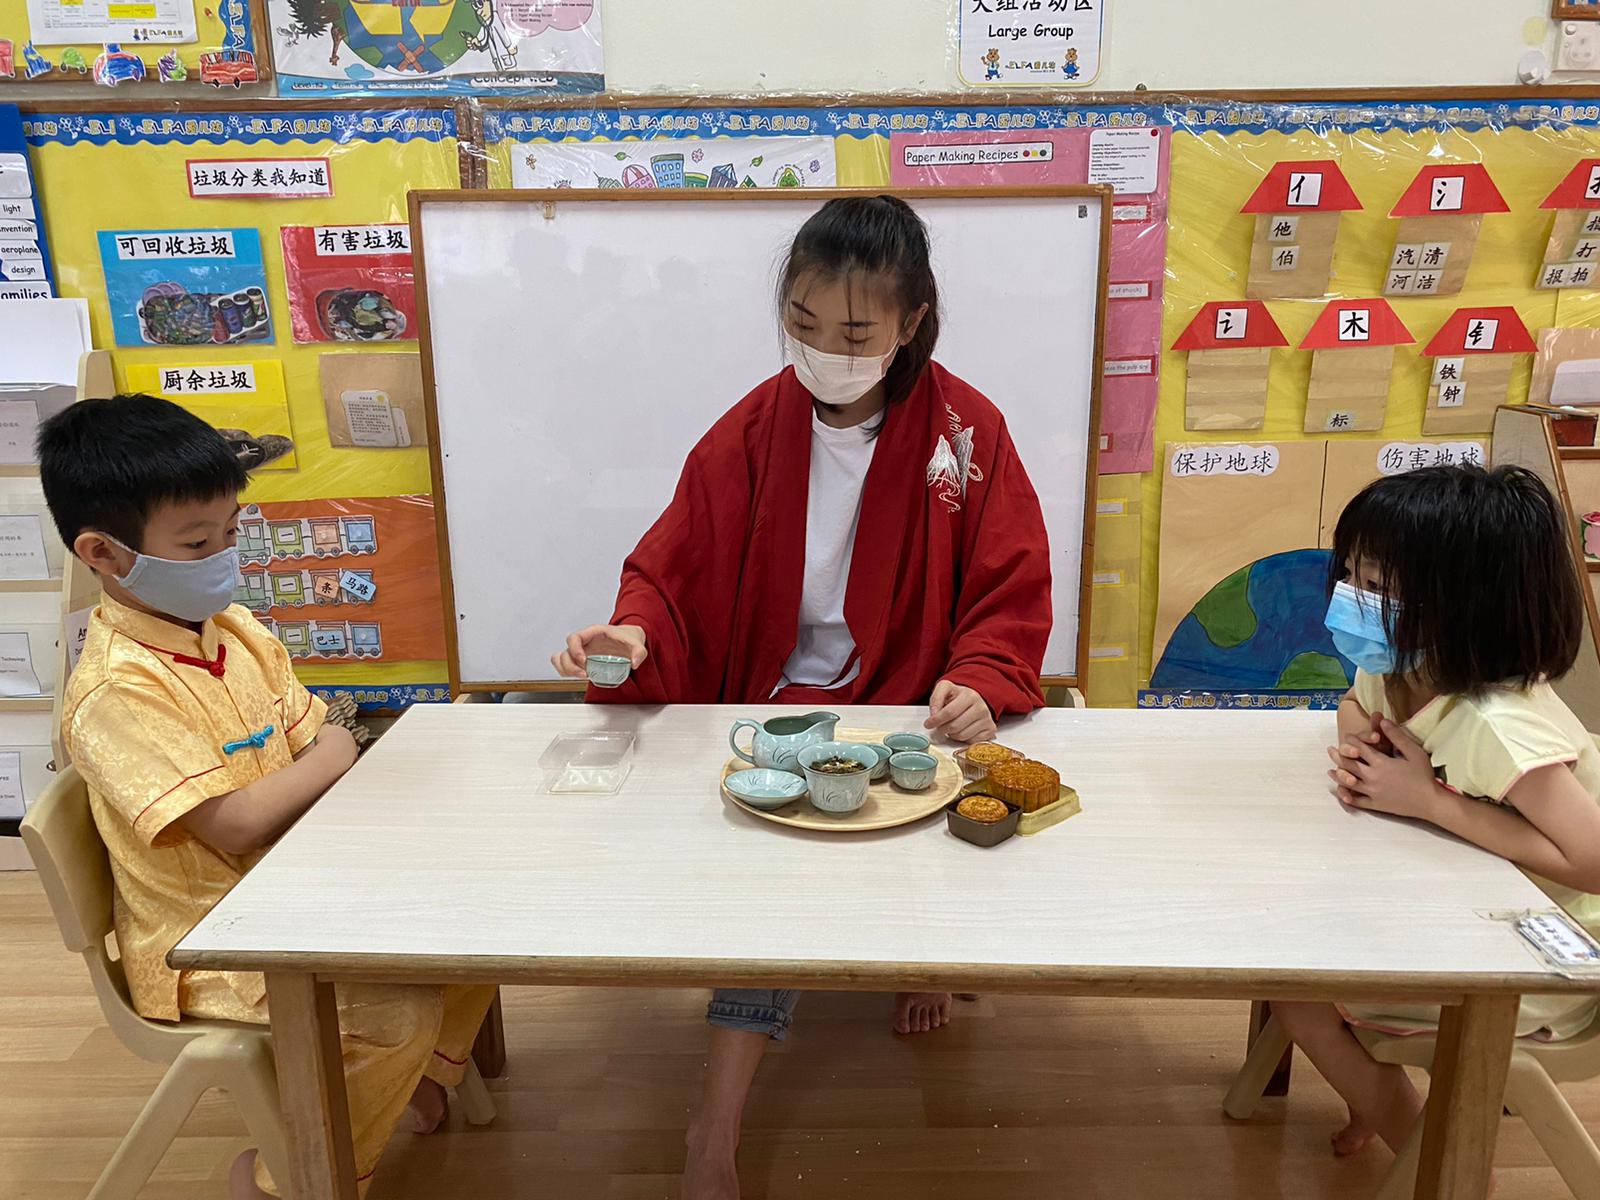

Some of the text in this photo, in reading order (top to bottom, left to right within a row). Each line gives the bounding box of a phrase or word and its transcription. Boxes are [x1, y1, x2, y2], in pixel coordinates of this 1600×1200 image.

[988, 24, 1074, 40] Large Group
[906, 149, 1019, 164] Paper Making Recipes
[194, 168, 327, 187] 垃圾分类我知道
[3, 204, 21, 214] light
[1273, 221, 1292, 237] 他
[118, 235, 233, 256] 可回收垃圾
[318, 229, 409, 252] 有害垃圾
[1, 246, 39, 254] aeroplane
[1277, 250, 1294, 266] 伯
[1396, 247, 1444, 265] 汽 清
[1577, 242, 1597, 259] 打
[12, 265, 36, 275] design
[1571, 267, 1589, 283] 拍
[1392, 274, 1436, 290] 河 洁
[1341, 311, 1368, 338] 木
[1439, 364, 1457, 379] 铁
[164, 369, 252, 391] 厨余垃圾
[1443, 386, 1461, 402] 钟
[1330, 413, 1349, 428] 标
[1174, 452, 1276, 474] 保护地球
[1382, 447, 1484, 469] 伤害地球
[321, 582, 333, 594] 条
[345, 577, 369, 596] 马路
[316, 635, 340, 646] 巴士
